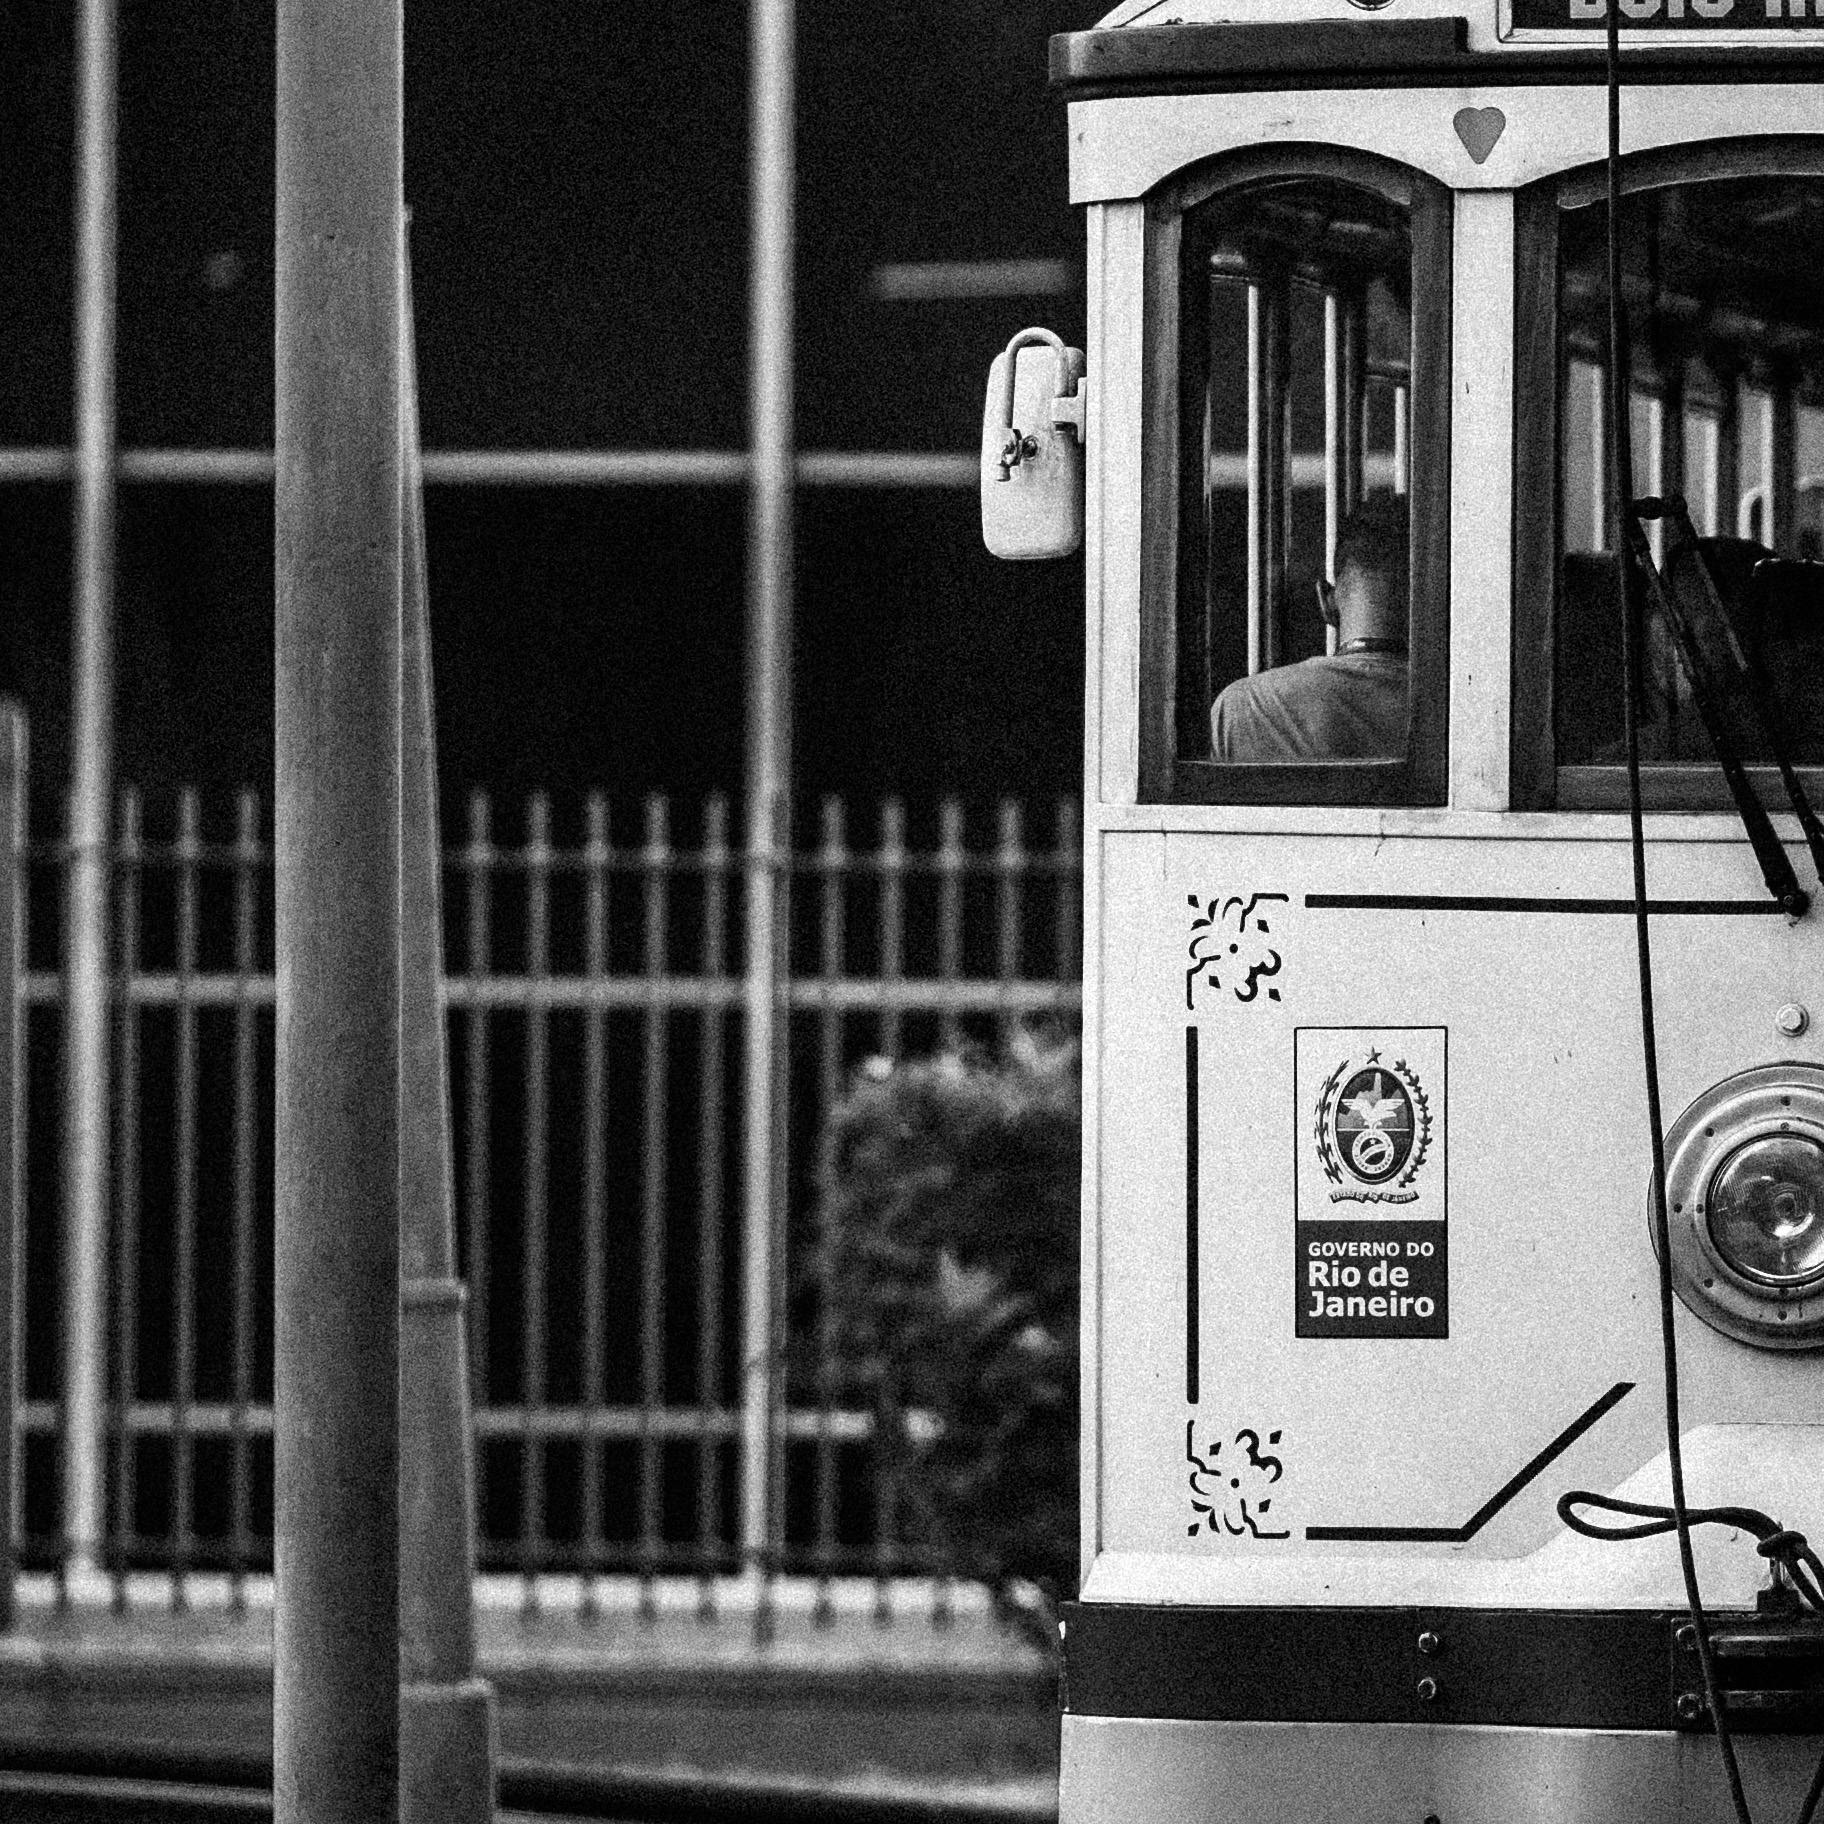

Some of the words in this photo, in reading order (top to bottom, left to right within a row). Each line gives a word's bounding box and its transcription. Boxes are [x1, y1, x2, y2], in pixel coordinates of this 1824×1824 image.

[1308, 1241, 1401, 1257] GOVERNO
[1406, 1241, 1435, 1257] DO
[1308, 1260, 1361, 1288] Rio
[1367, 1260, 1410, 1288] de
[1308, 1290, 1435, 1318] Janeiro
